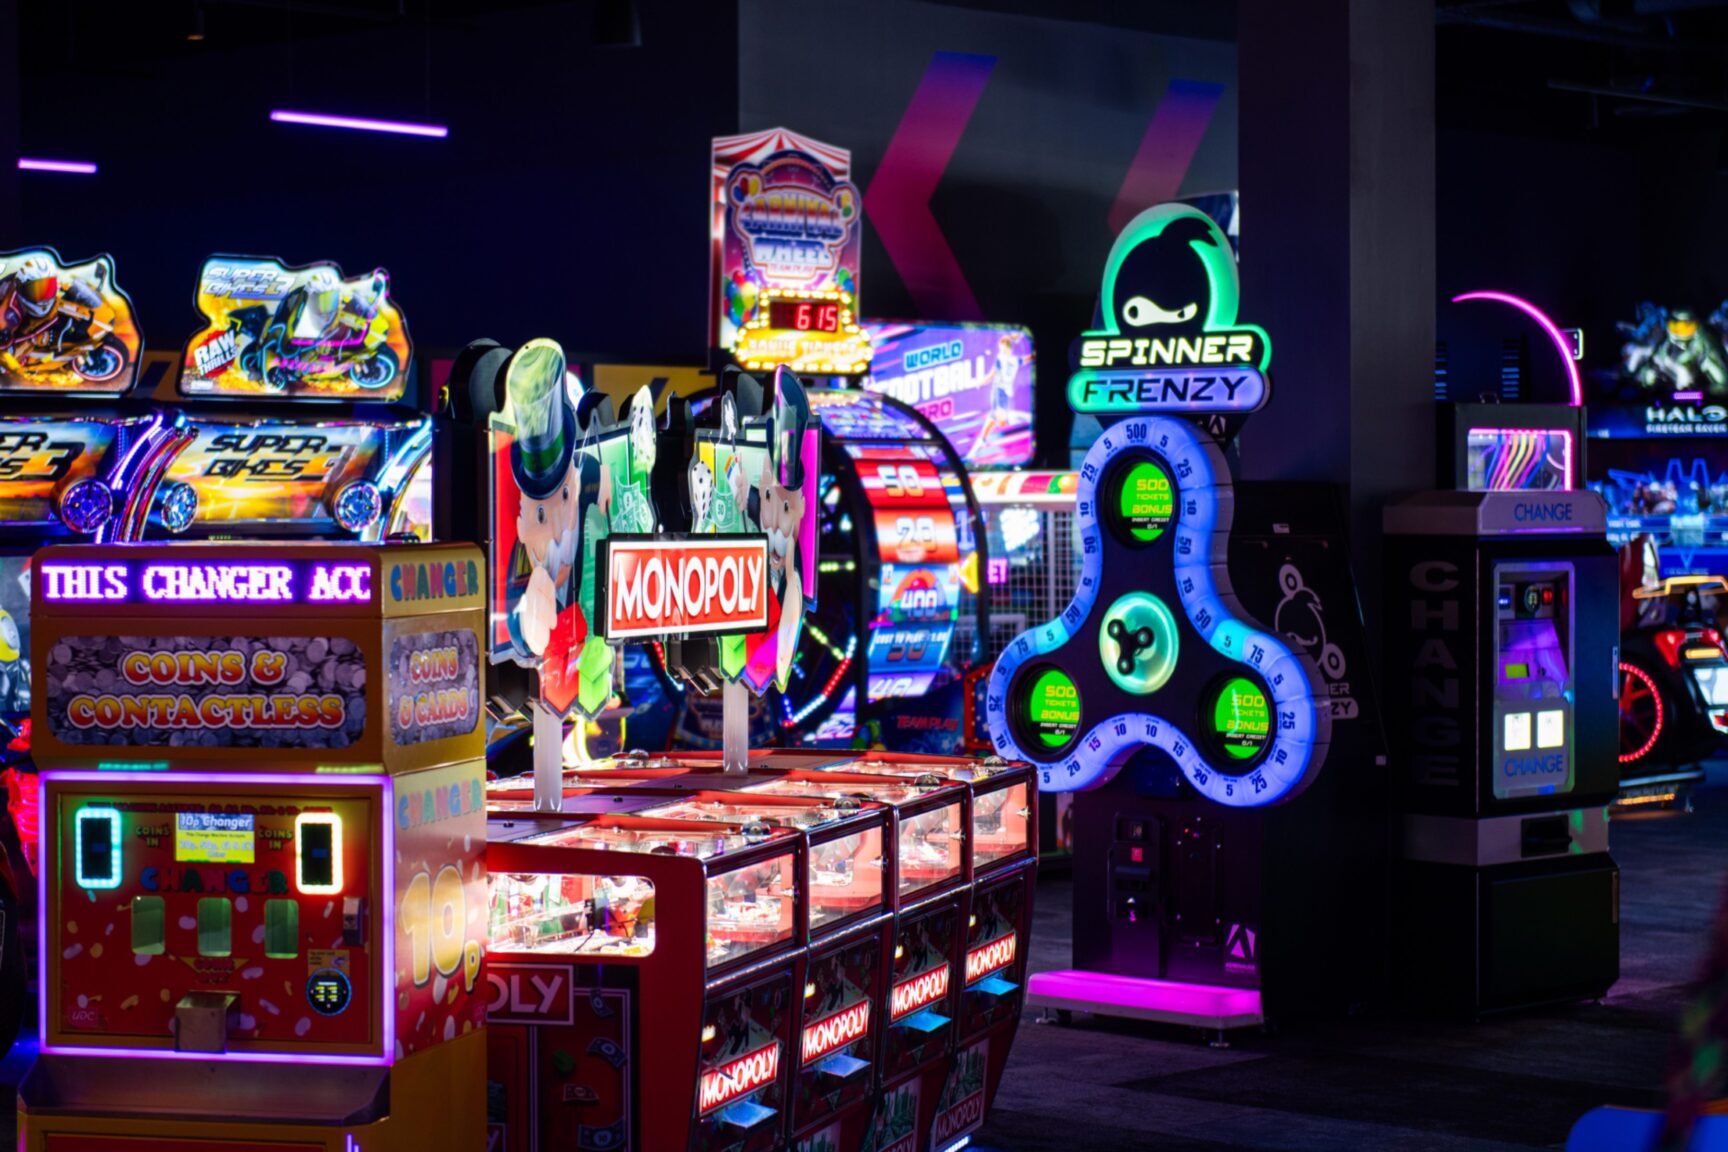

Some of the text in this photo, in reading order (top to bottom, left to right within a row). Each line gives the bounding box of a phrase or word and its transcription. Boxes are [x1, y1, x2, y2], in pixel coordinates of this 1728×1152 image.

[207, 267, 278, 282] SUPER
[194, 330, 236, 367] RAW
[904, 340, 963, 371] WORLD
[1080, 335, 1253, 367] SPINNER
[1083, 376, 1249, 404] FRENZY
[1646, 405, 1727, 422] HALO
[1126, 424, 1147, 439] 500
[205, 434, 328, 454] SUPER
[1103, 438, 1112, 450] 5
[1160, 435, 1169, 447] 5
[202, 459, 311, 478] BIKES
[1081, 462, 1096, 482] 25
[1177, 458, 1193, 479] 25
[877, 465, 924, 497] 50
[1136, 478, 1169, 491] 500
[1080, 502, 1089, 517] 10
[1132, 504, 1173, 514] BONUS
[1187, 500, 1197, 515] 10
[1514, 503, 1572, 521] CHANGE
[896, 516, 937, 552] 20
[1179, 536, 1192, 555] 50
[41, 565, 371, 600] THIS CHANGER ACC
[390, 560, 479, 601] CHANGER
[614, 555, 763, 621] MONOPOLY
[1182, 577, 1195, 593] 15
[1065, 606, 1081, 624] 50
[1195, 608, 1212, 630] 50
[1046, 630, 1054, 642] 5
[1224, 635, 1232, 648] 5
[1015, 637, 1029, 655] 75
[1250, 644, 1265, 664] 75
[122, 650, 288, 685] COINS &
[409, 646, 459, 684] COINS
[1273, 674, 1284, 686] 5
[1045, 685, 1077, 698] 500
[1231, 694, 1265, 707] 500
[67, 694, 346, 729] CONTACTLESS
[415, 687, 469, 726] CARDS
[1041, 709, 1080, 720] BONUS
[1115, 723, 1127, 736] 10
[1226, 720, 1270, 731] BONUS
[1282, 711, 1295, 730] 25
[1145, 724, 1157, 738] 10
[1088, 737, 1101, 752] 15
[1172, 740, 1185, 757] 15
[1275, 750, 1288, 766] 10
[1504, 754, 1563, 777] CHANGE
[1044, 771, 1050, 783] 5
[1067, 760, 1081, 777] 20
[1193, 767, 1208, 785] 20
[1226, 784, 1233, 796] 5
[1252, 774, 1268, 794] 25
[398, 778, 483, 830] CHANGER
[181, 815, 251, 830] 10p Changer
[136, 827, 170, 837] COINS
[259, 829, 293, 839] COINS
[146, 838, 159, 847] IN
[269, 840, 282, 850] IN
[140, 867, 288, 894] CHANGER
[401, 864, 482, 993] 10p
[966, 936, 1016, 981] MONOPOLY
[893, 968, 949, 1016] MONOPOLY
[805, 1005, 868, 1061] MONOPOLY
[702, 1047, 777, 1108] MONOPOLY
